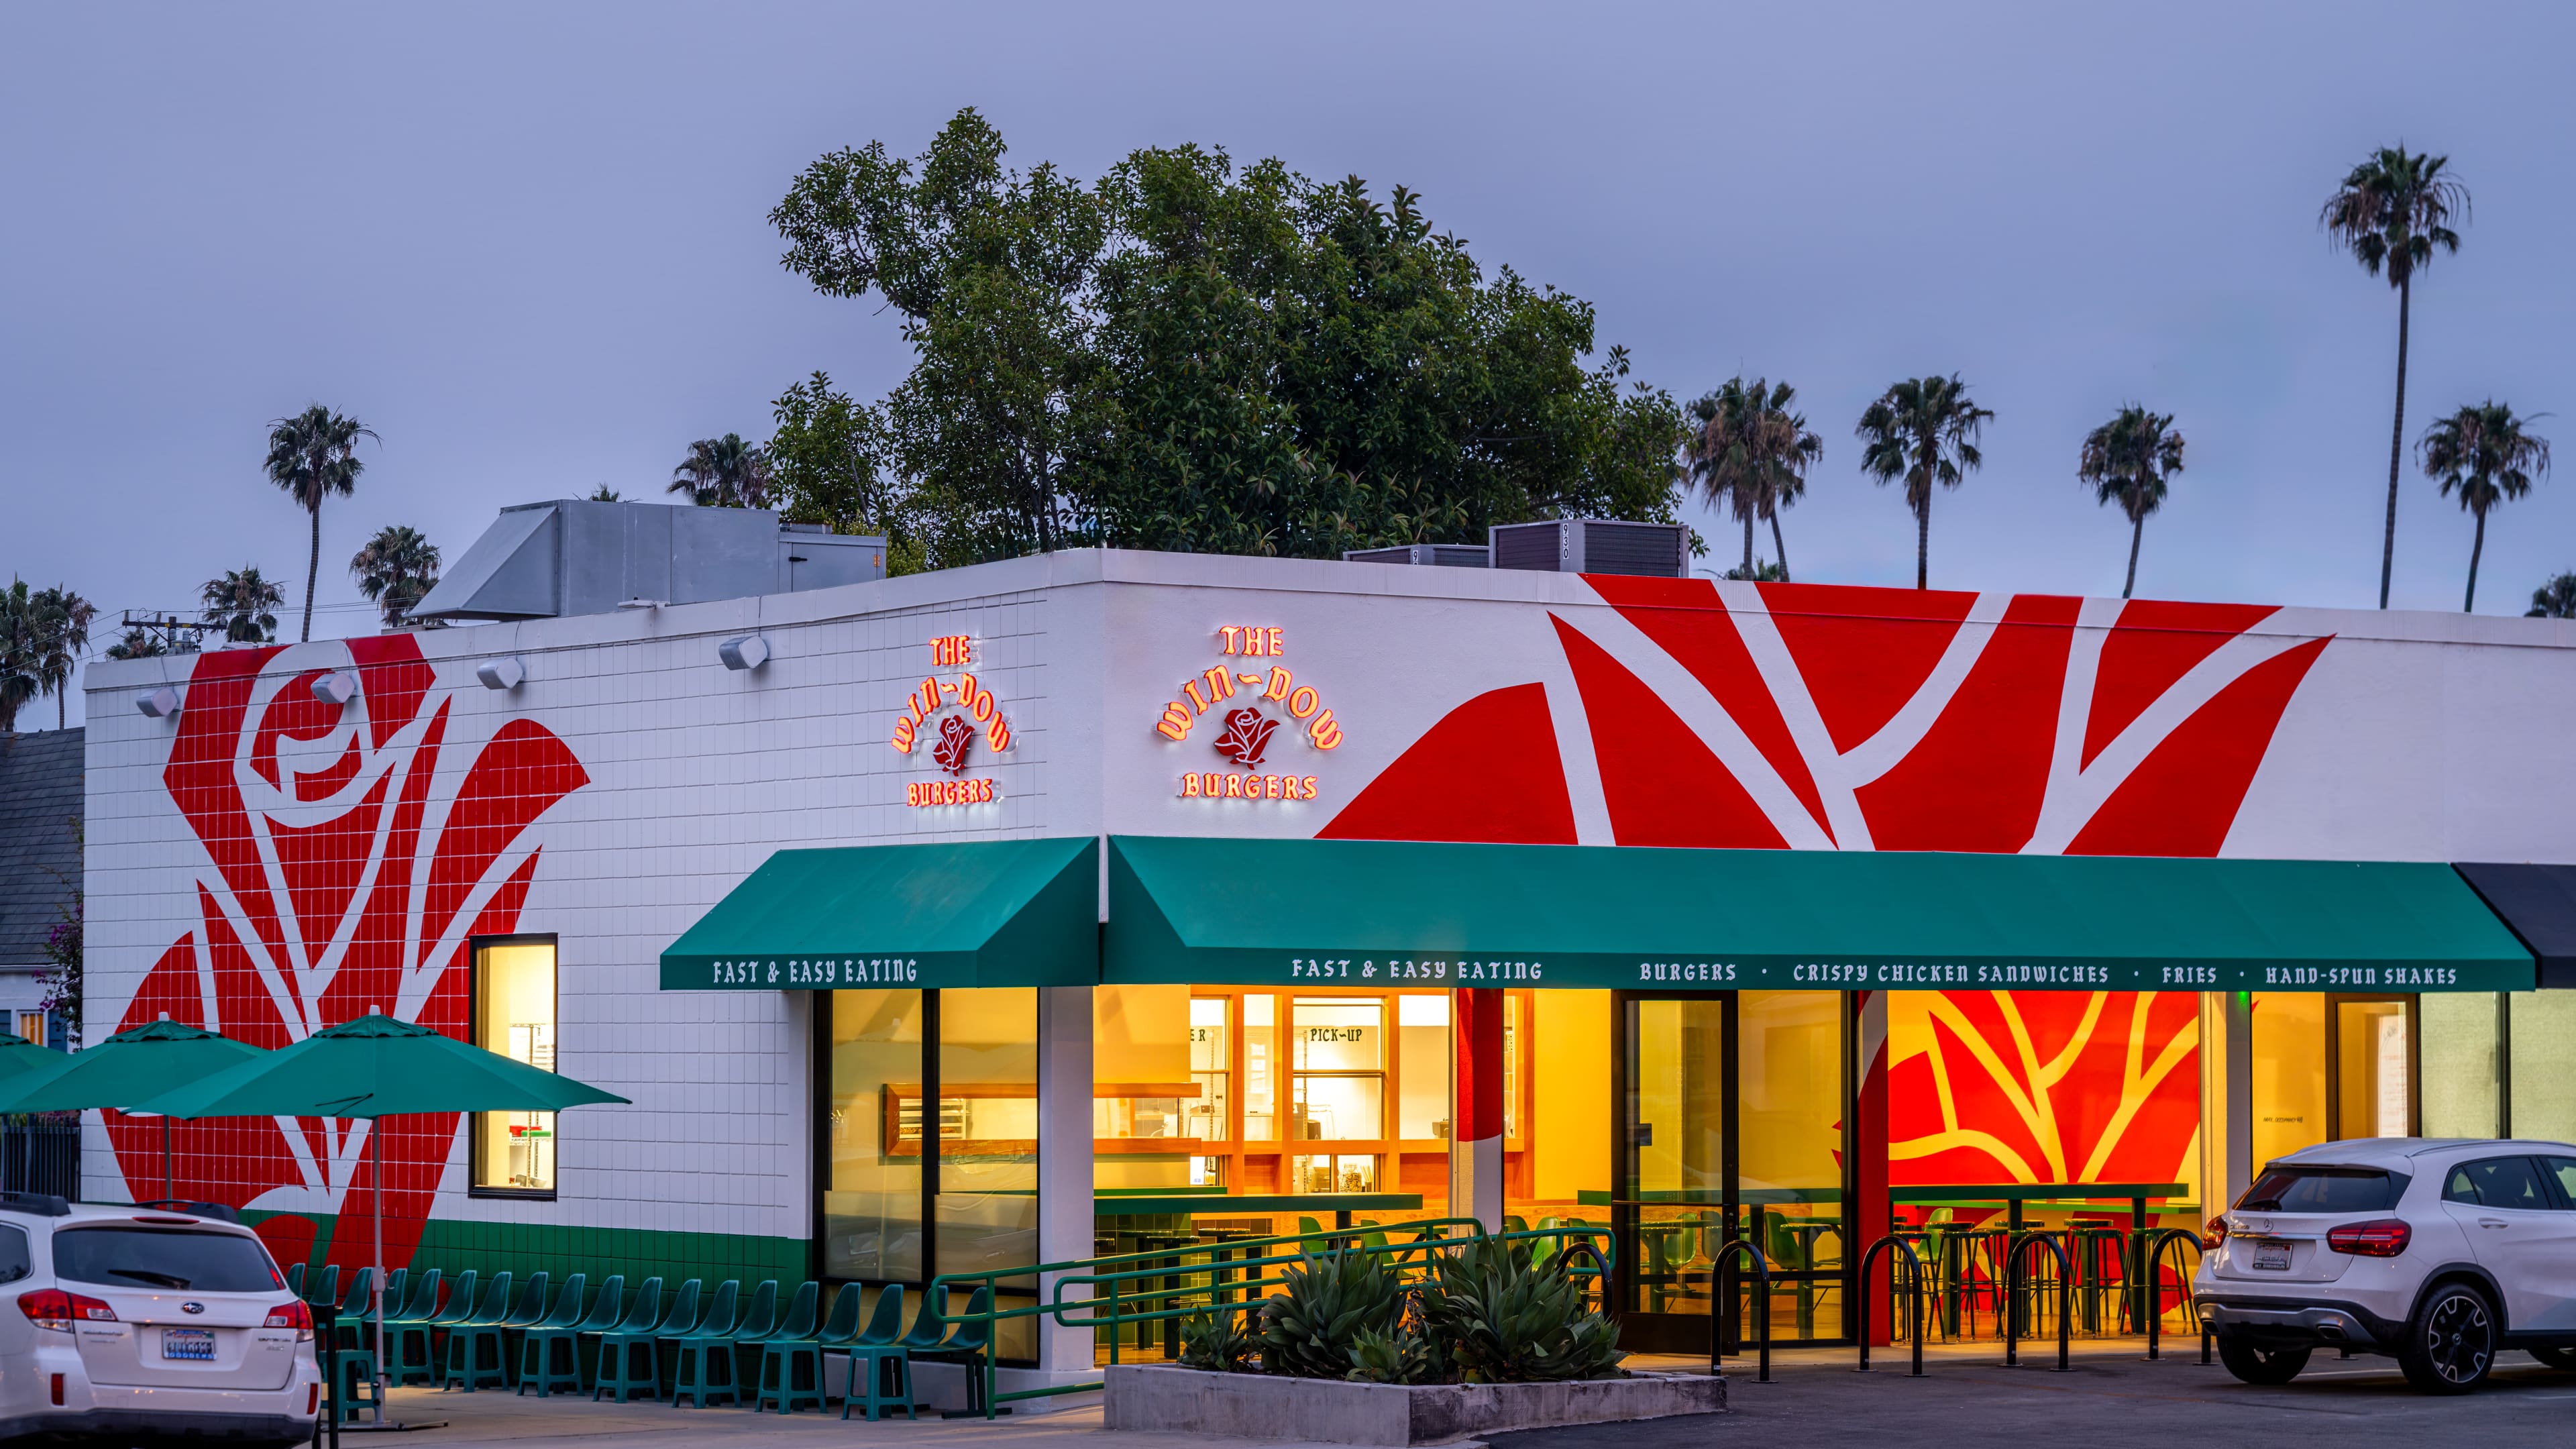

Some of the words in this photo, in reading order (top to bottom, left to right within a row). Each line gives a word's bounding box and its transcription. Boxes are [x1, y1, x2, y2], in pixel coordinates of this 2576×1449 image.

[929, 635, 971, 666] THE
[1219, 626, 1283, 656] THE
[907, 779, 993, 806] BURGERS
[1183, 772, 1318, 800] BURGERS
[713, 961, 758, 983] FAST
[768, 961, 780, 983] &
[790, 961, 835, 983] EASY
[845, 959, 916, 982] EATING
[1293, 959, 1350, 977] FAST
[1362, 961, 1377, 978] &
[1389, 960, 1446, 979] EASY
[1457, 961, 1542, 980] EATING
[1640, 963, 1736, 981] BURGERS
[1794, 964, 1868, 982] CRISPY
[1878, 965, 1968, 982] CHICKEN
[1978, 966, 2108, 983] SANDWICHES
[2162, 967, 2216, 983] FRIES
[2266, 968, 2375, 984] HAND-SPUN
[2385, 968, 2457, 984] SHAKES
